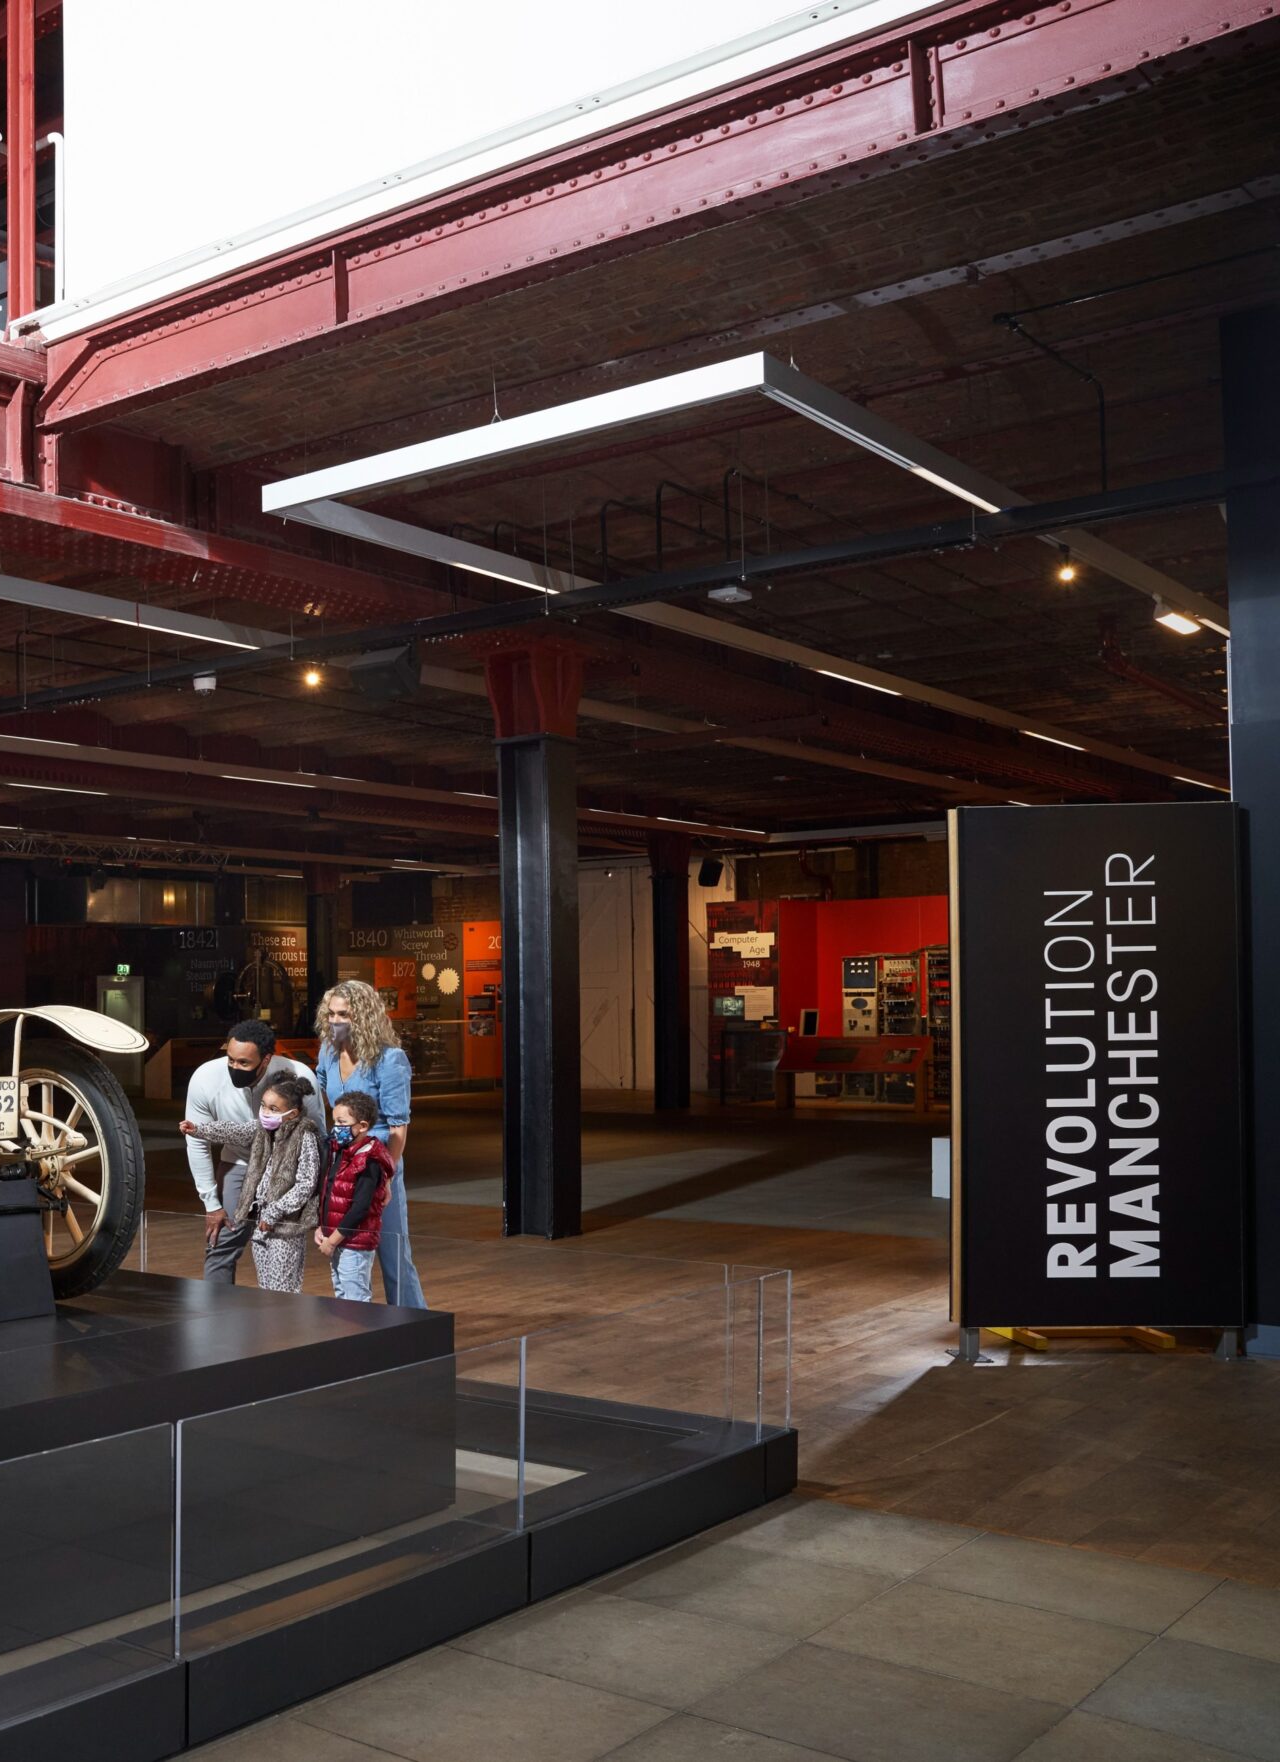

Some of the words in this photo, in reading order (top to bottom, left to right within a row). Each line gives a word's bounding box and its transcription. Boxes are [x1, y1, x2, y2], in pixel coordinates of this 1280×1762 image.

[179, 929, 215, 949] 1842
[251, 932, 280, 947] These
[281, 936, 297, 947] are
[349, 930, 387, 948] 1840
[393, 926, 444, 940] Whitworth
[718, 935, 759, 945] Computer
[401, 940, 429, 950] Screw
[749, 946, 765, 955] Age
[414, 949, 448, 961] Thread
[392, 961, 416, 977] 1872
[742, 960, 760, 968] 1948
[1104, 852, 1161, 1279] MANCHESTER
[1043, 890, 1097, 1279] REVOLUTION
